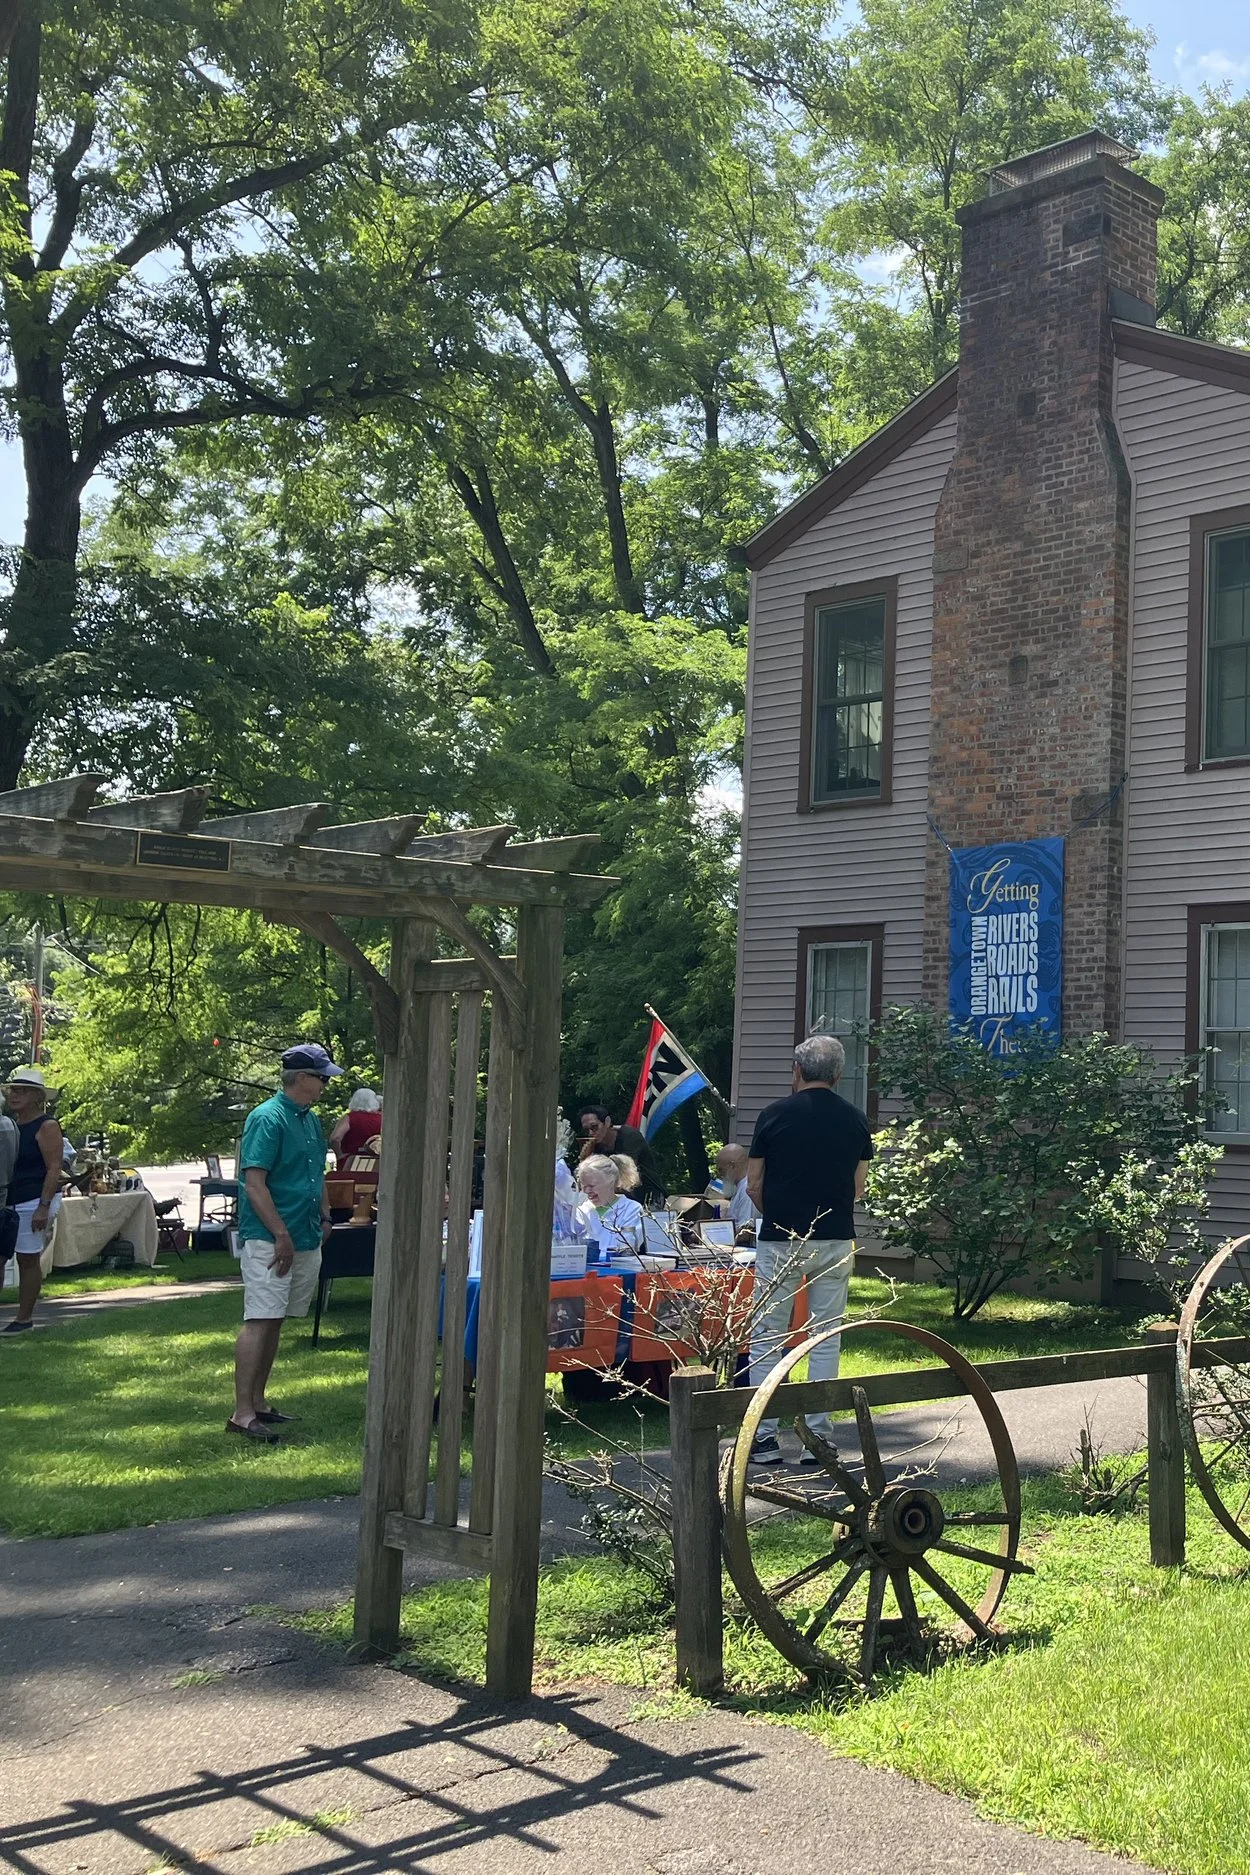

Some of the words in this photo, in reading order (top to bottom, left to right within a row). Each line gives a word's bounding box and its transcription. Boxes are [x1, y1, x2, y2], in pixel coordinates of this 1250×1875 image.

[967, 858, 1039, 914] Getting
[987, 911, 1039, 945] RIVERS
[971, 916, 988, 1016] ORANGETOWN
[987, 942, 1039, 977] ROADS
[987, 974, 1039, 1015] RAILS
[979, 1014, 1029, 1054] The
